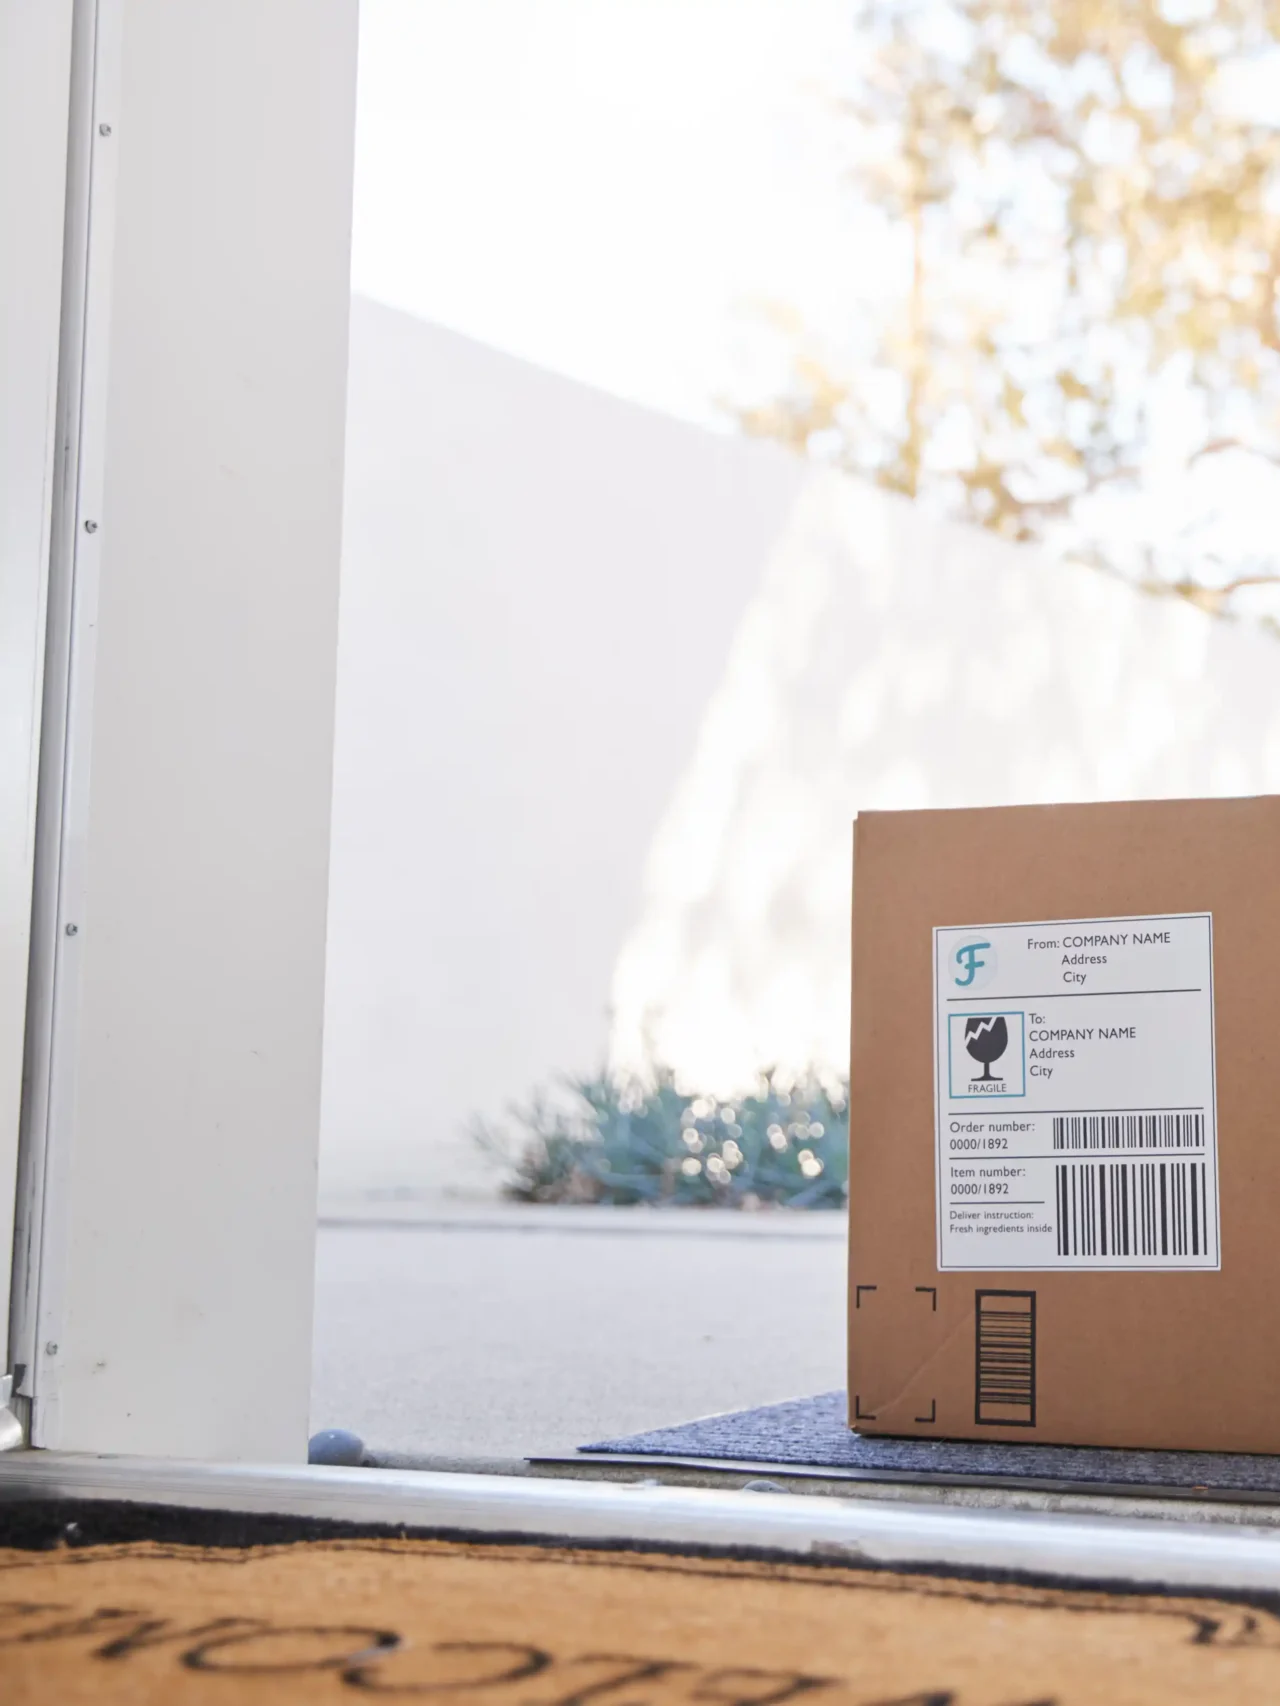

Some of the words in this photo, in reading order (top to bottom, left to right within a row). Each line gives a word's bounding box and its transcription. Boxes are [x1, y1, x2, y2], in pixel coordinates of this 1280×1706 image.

[1028, 939, 1059, 949] From:
[1063, 934, 1128, 948] COMPANY
[1133, 932, 1170, 944] NAME
[1062, 954, 1107, 965] Address
[1063, 971, 1086, 985] City
[1029, 1013, 1045, 1024] To:
[1029, 1029, 1094, 1041] COMPANY
[1099, 1027, 1136, 1039] NAME
[1029, 1048, 1074, 1058] Address
[1030, 1065, 1053, 1079] City
[968, 1084, 1006, 1092] FRAGILE
[950, 1122, 984, 1133] Order
[989, 1121, 1034, 1132] number:
[950, 1138, 1008, 1150] 0000/1892
[951, 1167, 975, 1177] Item
[980, 1166, 1025, 1177] number:
[951, 1183, 1008, 1194] 0000/1892
[950, 1211, 980, 1219] Deliver
[950, 1224, 973, 1233] Fresh
[977, 1225, 1024, 1235] ingredients
[1027, 1224, 1052, 1232] inside
